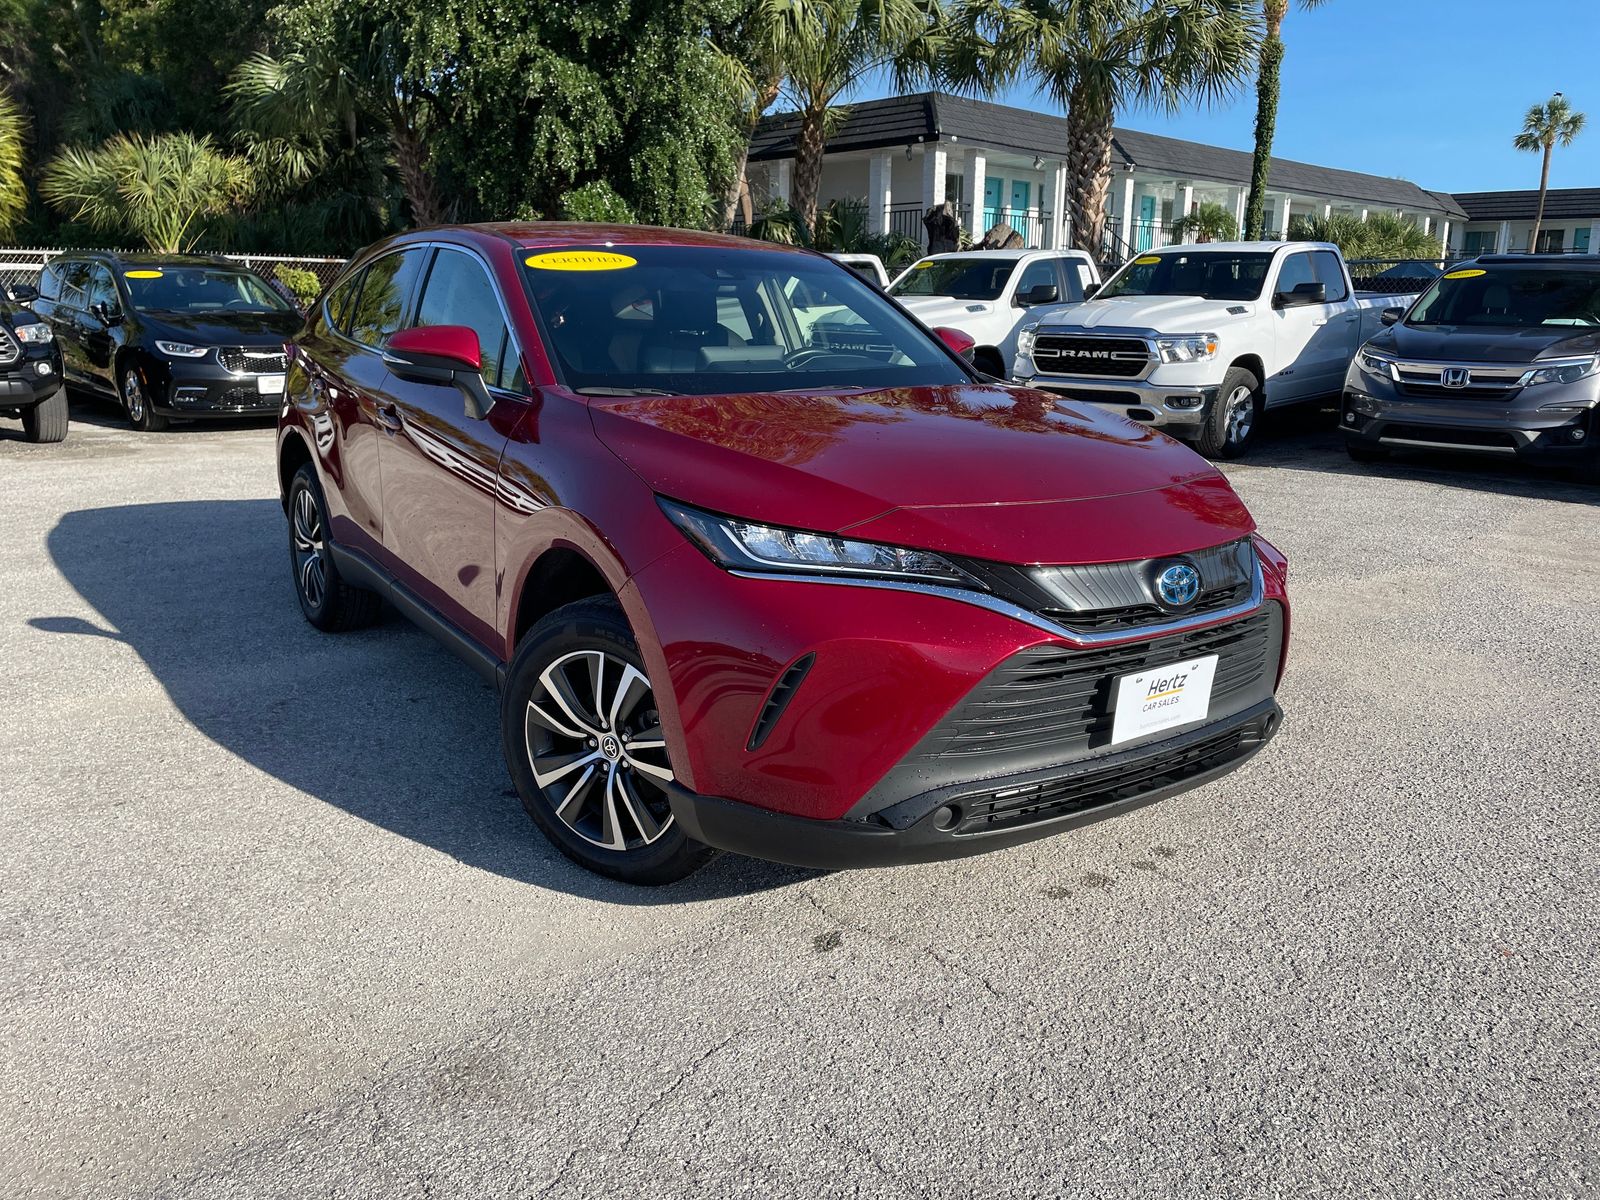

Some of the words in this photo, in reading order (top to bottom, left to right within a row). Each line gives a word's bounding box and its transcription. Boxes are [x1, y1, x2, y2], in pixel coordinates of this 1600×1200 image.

[540, 256, 623, 265] CERTIFIED
[1061, 349, 1109, 359] RAM
[1147, 673, 1188, 696] Hertz
[1142, 702, 1156, 713] CAR
[1157, 696, 1180, 708] SALES
